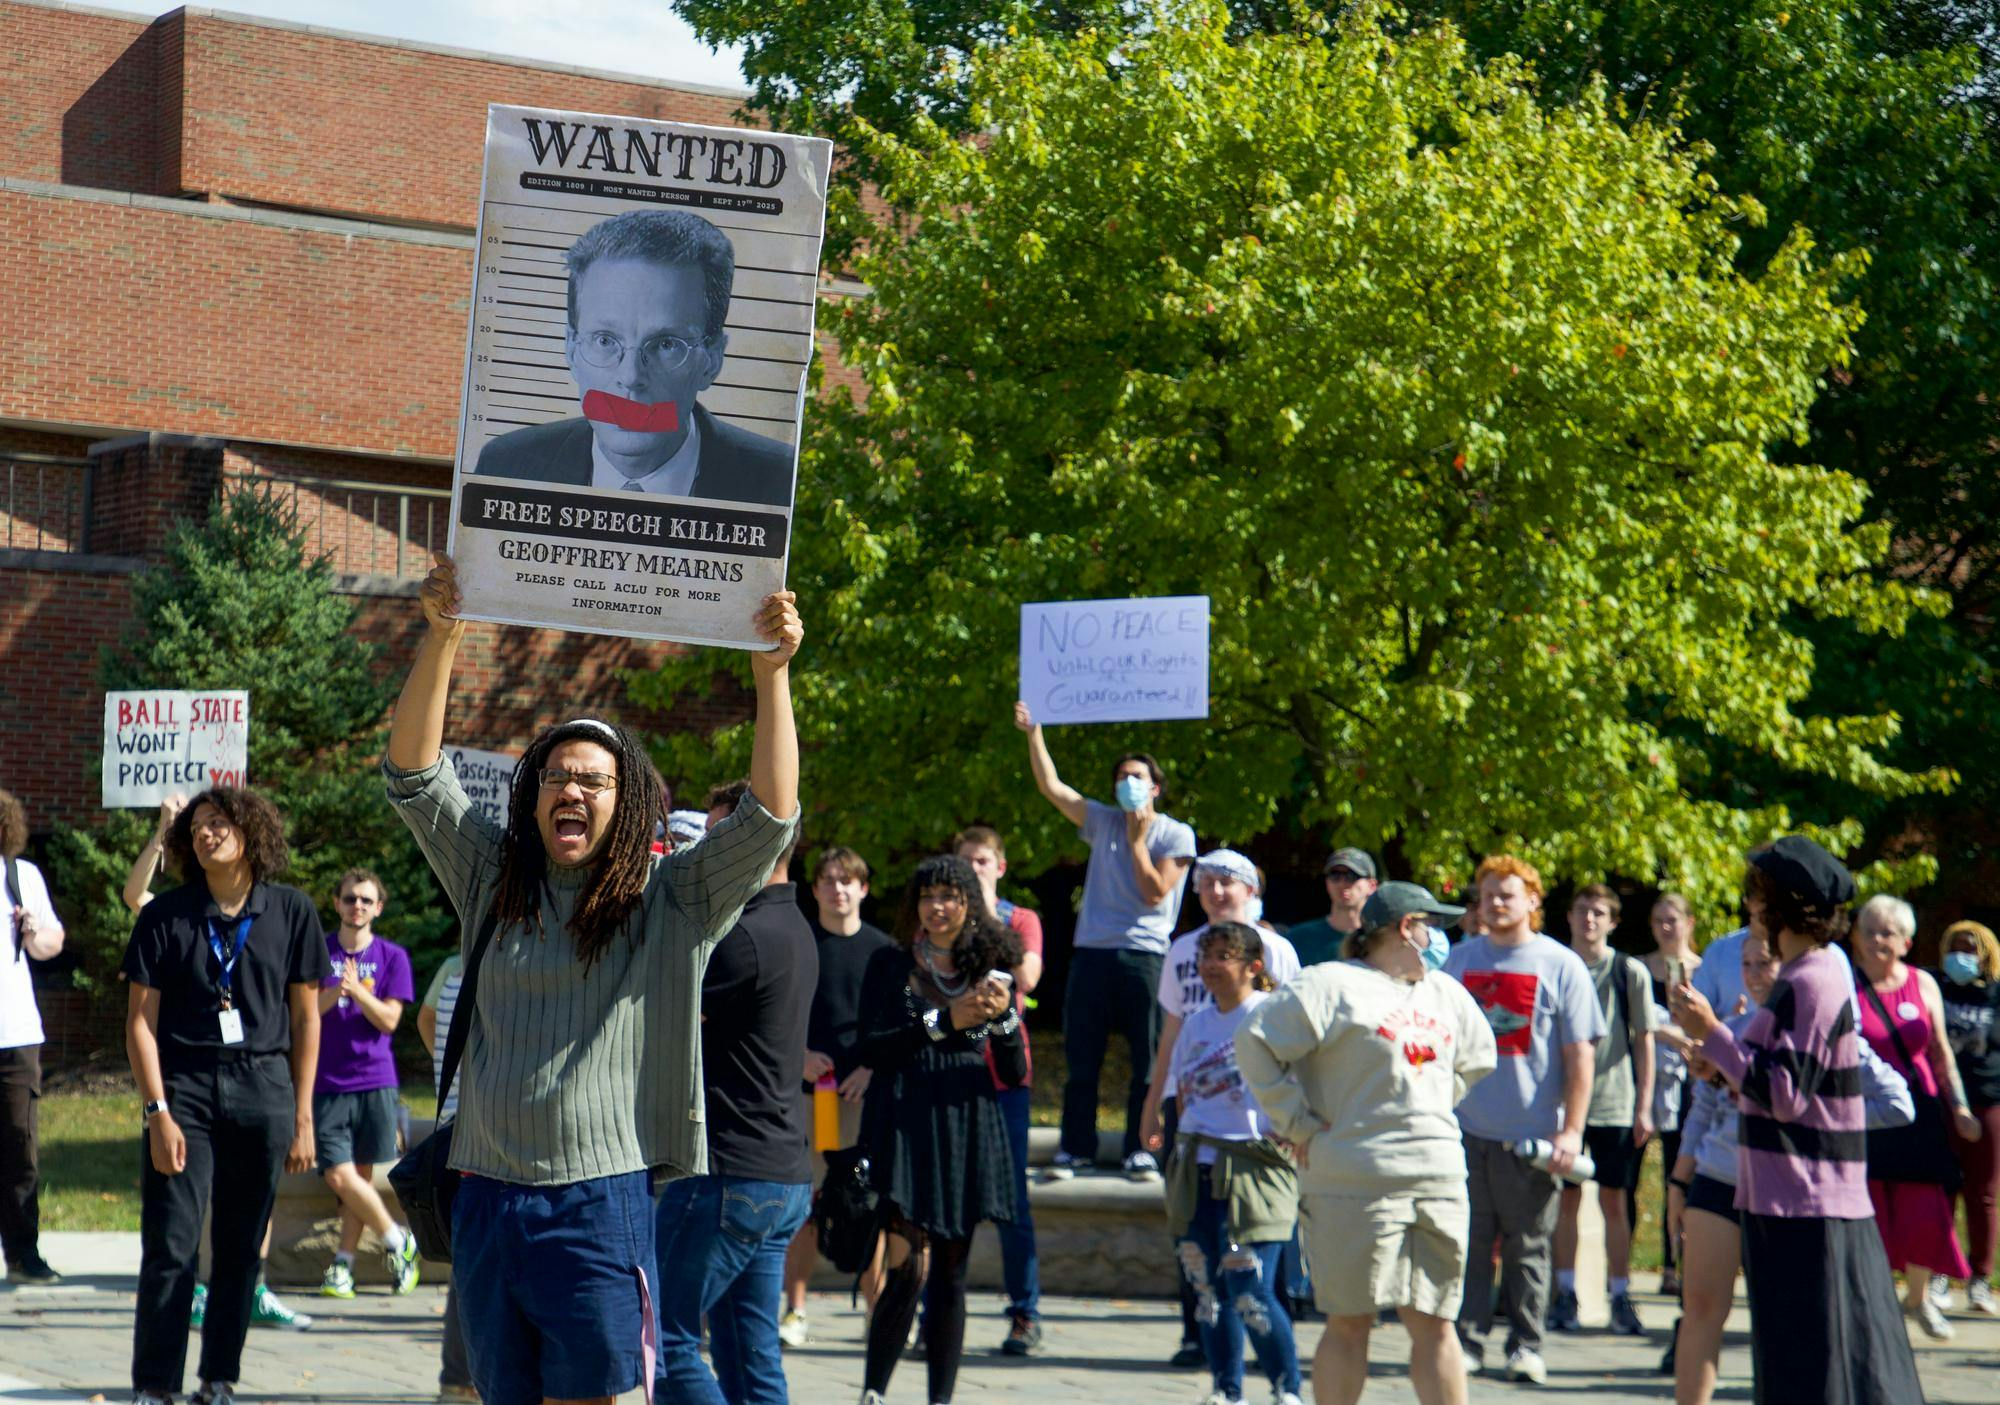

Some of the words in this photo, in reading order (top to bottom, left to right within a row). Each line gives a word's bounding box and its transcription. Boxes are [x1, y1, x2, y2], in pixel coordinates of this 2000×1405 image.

[522, 118, 787, 189] WANTED
[527, 177, 561, 187] EDITION
[603, 185, 623, 194] MOST
[627, 188, 656, 198] WANTED
[660, 191, 690, 201] PERSON
[713, 197, 732, 206] SEPT
[756, 202, 775, 210] 2025
[487, 236, 499, 244] 05
[485, 266, 497, 274] 10
[482, 296, 494, 304] 15
[480, 325, 491, 333] 20
[475, 384, 486, 392] 30
[472, 414, 483, 422] 35
[482, 498, 552, 525] FREE
[559, 506, 662, 536] SPEECH
[669, 517, 766, 547] KILLER
[498, 539, 632, 571] GEOFFREY
[635, 553, 744, 582] MEARNS
[516, 572, 565, 586] PLEASE
[573, 579, 606, 590] CALL
[614, 583, 647, 594] ACLU
[656, 587, 680, 598] FOR
[688, 590, 721, 602] MORE
[572, 598, 662, 615] INFORMATION
[1038, 610, 1100, 653] NO
[1111, 609, 1199, 640] PEACE
[118, 698, 180, 729] BALL
[190, 698, 244, 726] STATE
[117, 732, 180, 754] WONT
[118, 762, 207, 787] PROTECT
